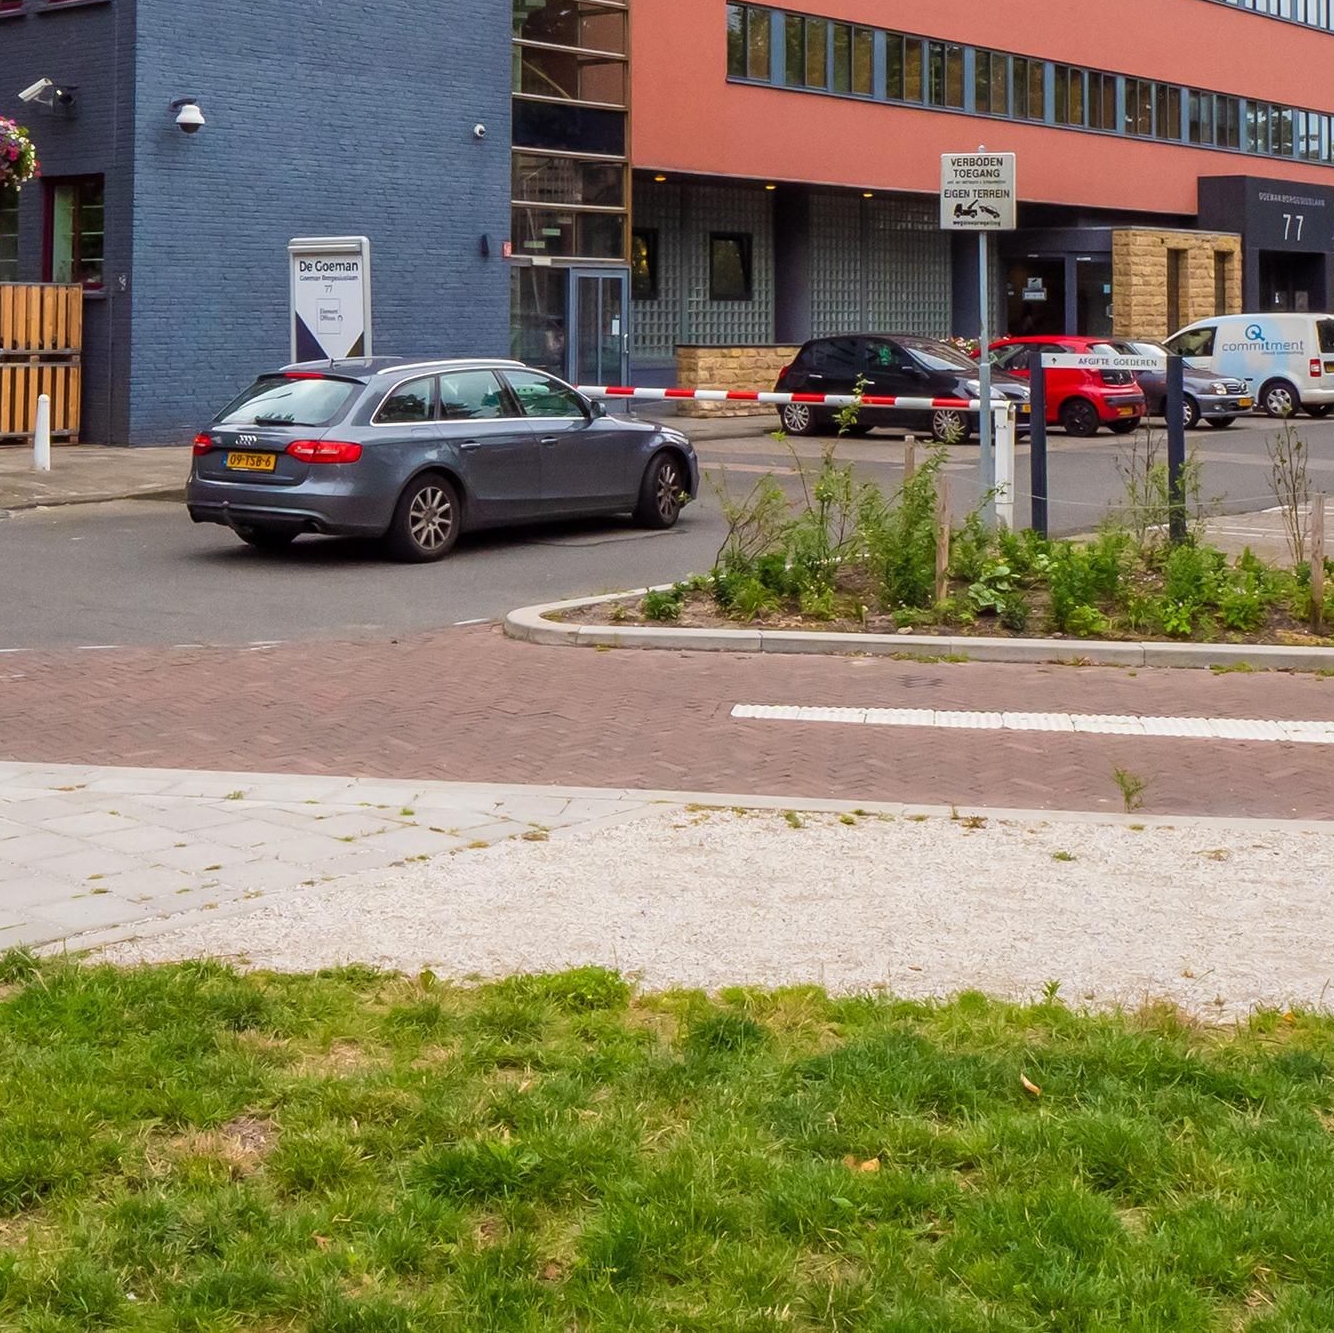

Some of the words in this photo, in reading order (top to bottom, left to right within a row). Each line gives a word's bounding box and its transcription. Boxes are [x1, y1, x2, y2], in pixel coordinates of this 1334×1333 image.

[951, 157, 1003, 167] VERBODEN
[953, 169, 1000, 178] TOEGANG
[944, 189, 970, 198] EIGEN
[973, 189, 1010, 198] TERREIN
[1283, 214, 1304, 241] 77
[299, 260, 313, 272] De
[315, 260, 359, 272] Goeman
[324, 285, 333, 293] 77
[1222, 340, 1304, 352] commitment
[1078, 357, 1109, 365] AFGIFTE
[1114, 358, 1157, 366] GOEDEREN
[230, 454, 271, 467] 09-TSB-6
